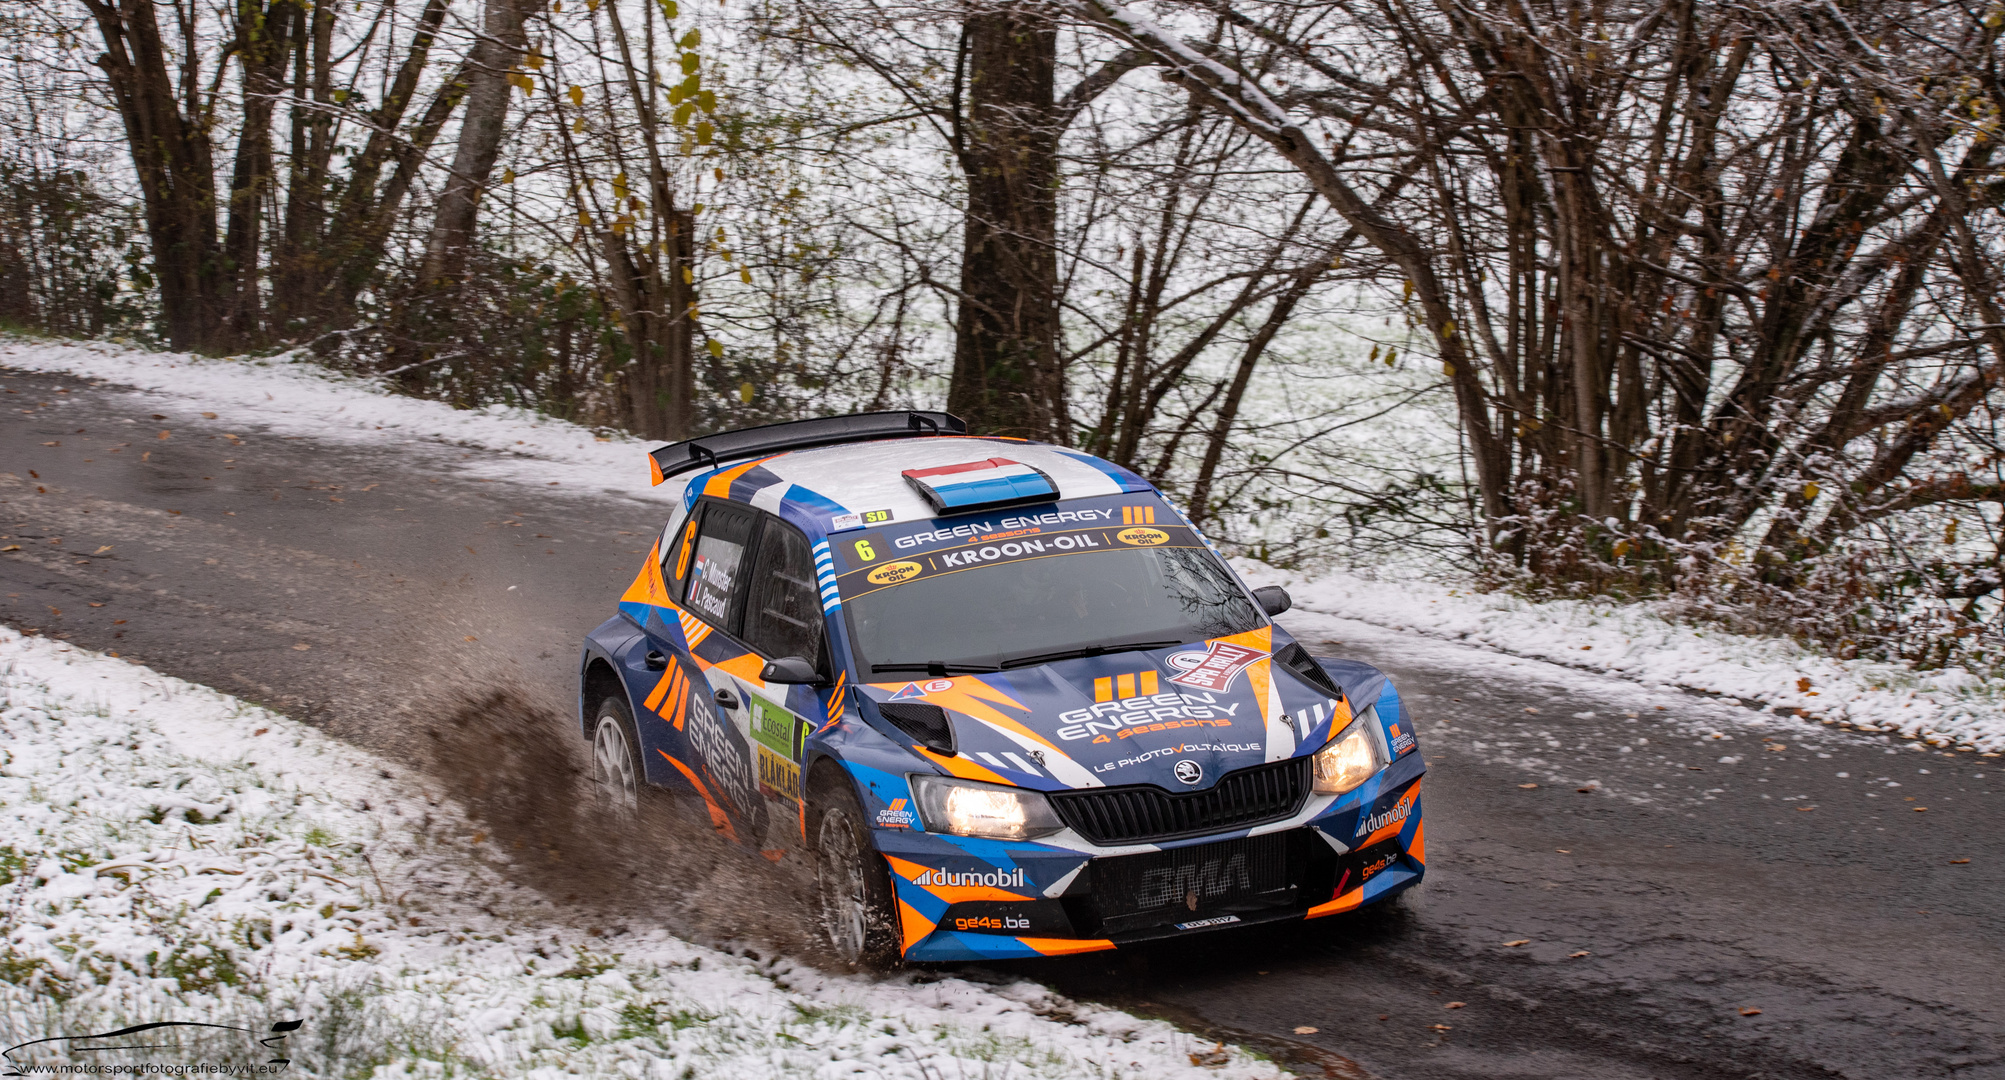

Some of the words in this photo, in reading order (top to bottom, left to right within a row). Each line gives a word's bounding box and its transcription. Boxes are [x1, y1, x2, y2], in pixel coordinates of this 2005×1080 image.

[866, 510, 888, 522] SD
[894, 521, 993, 549] GREEN
[1000, 508, 1113, 530] ENERGY
[967, 535, 979, 543] 4
[980, 527, 1041, 541] seasons
[1124, 532, 1163, 541] KROON
[676, 520, 696, 580] 6
[854, 539, 876, 561] 6
[942, 534, 1099, 568] KROON-OIL
[874, 565, 915, 581] KROON
[888, 574, 907, 582] OIL
[1181, 667, 1221, 687] SPA
[1204, 645, 1250, 670] RALLY
[931, 681, 946, 691] E
[1056, 702, 1239, 741] ENERGY
[1058, 692, 1217, 725] GREEN
[762, 708, 791, 743] Ecostal
[1092, 734, 1112, 744] 4
[1116, 718, 1232, 740] seasons
[693, 692, 749, 791] GREEN
[1390, 731, 1410, 747] GREEN
[1393, 736, 1415, 754] ENERGY
[1094, 761, 1117, 773] LE
[1118, 742, 1262, 768] PHOTOVOLTAÏQUE
[689, 718, 757, 826] ENERGY
[759, 753, 801, 799] BLÅKLÄD
[876, 816, 915, 825] ENERGY
[880, 809, 913, 818] GREEN
[1367, 797, 1412, 833] dumobil
[932, 866, 1024, 887] dumobil
[1362, 852, 1397, 881] ge4s.be
[955, 916, 1030, 930] ge4s.be
